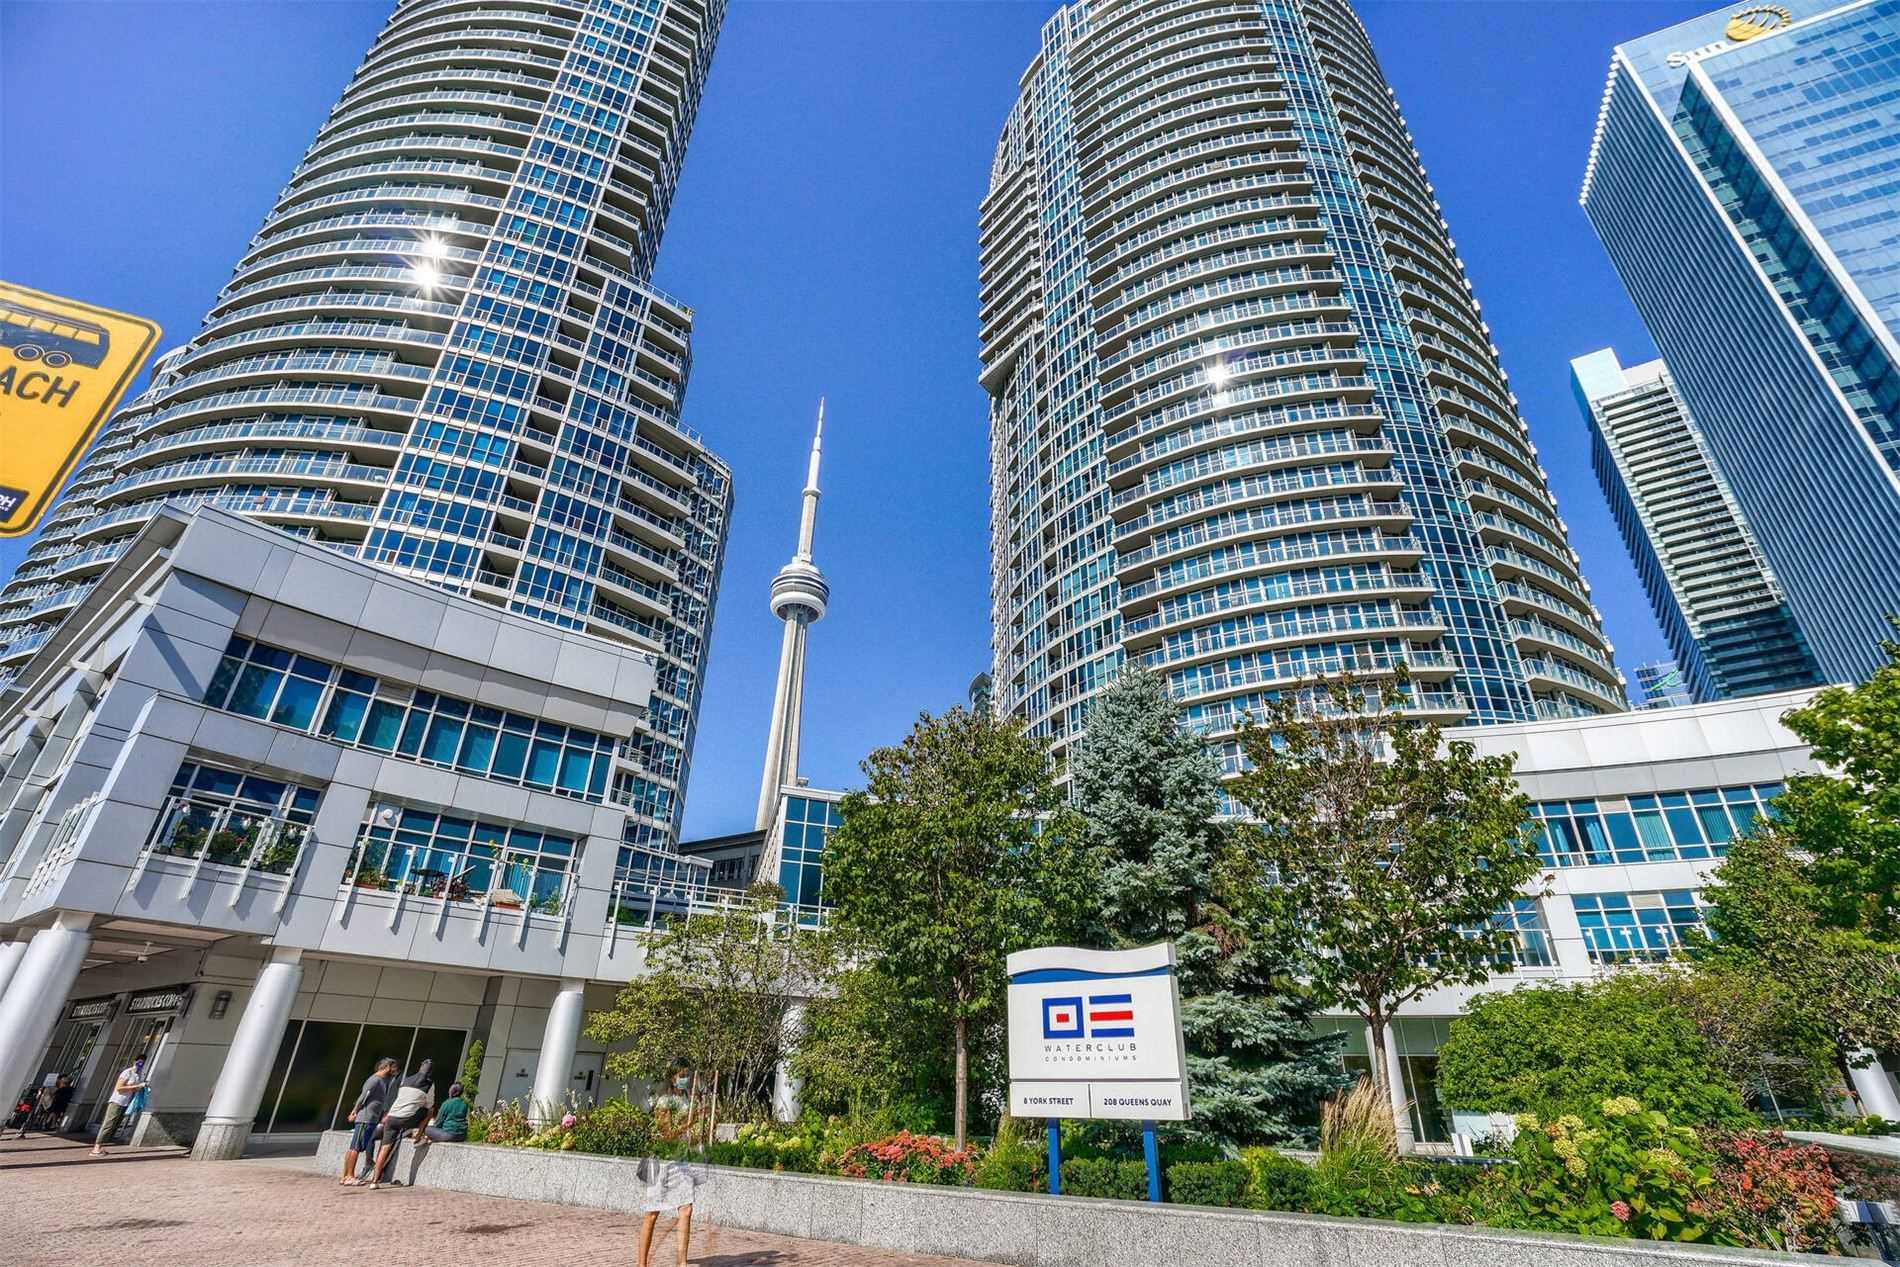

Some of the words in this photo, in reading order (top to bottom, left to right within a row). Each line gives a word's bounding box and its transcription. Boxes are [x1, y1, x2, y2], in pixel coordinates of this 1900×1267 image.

[1044, 1043, 1136, 1052] WATERCLUB
[1028, 1097, 1048, 1105] YORK
[1049, 1097, 1074, 1105] STREET
[1103, 1098, 1117, 1106] 208
[1118, 1098, 1149, 1106] QUEENS
[1150, 1098, 1172, 1107] QUAY
